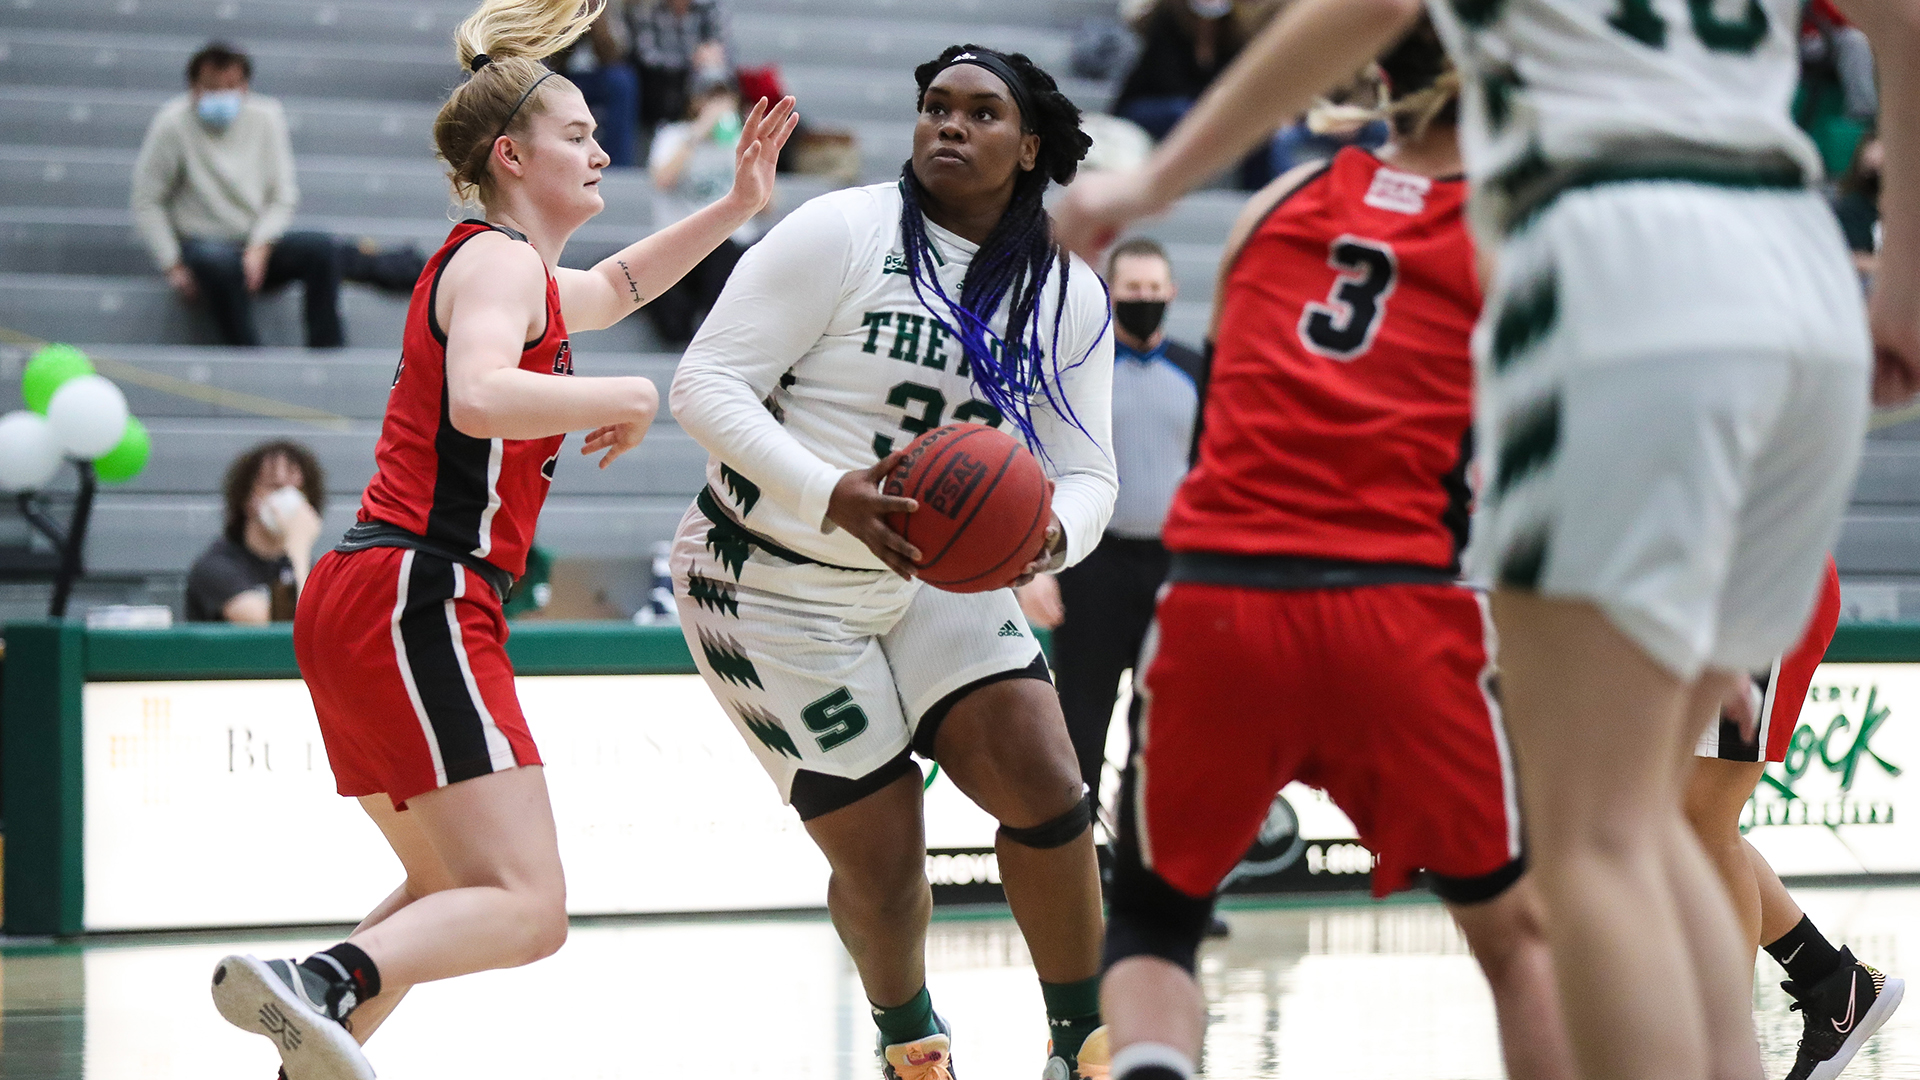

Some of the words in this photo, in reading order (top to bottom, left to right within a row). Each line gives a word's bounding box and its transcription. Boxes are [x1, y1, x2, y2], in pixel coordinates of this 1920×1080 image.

[884, 255, 921, 268] PSA
[1297, 233, 1398, 362] 3
[861, 311, 951, 371] THE
[931, 454, 982, 514] PSAC
[800, 685, 869, 754] S
[1764, 682, 1903, 800] ock
